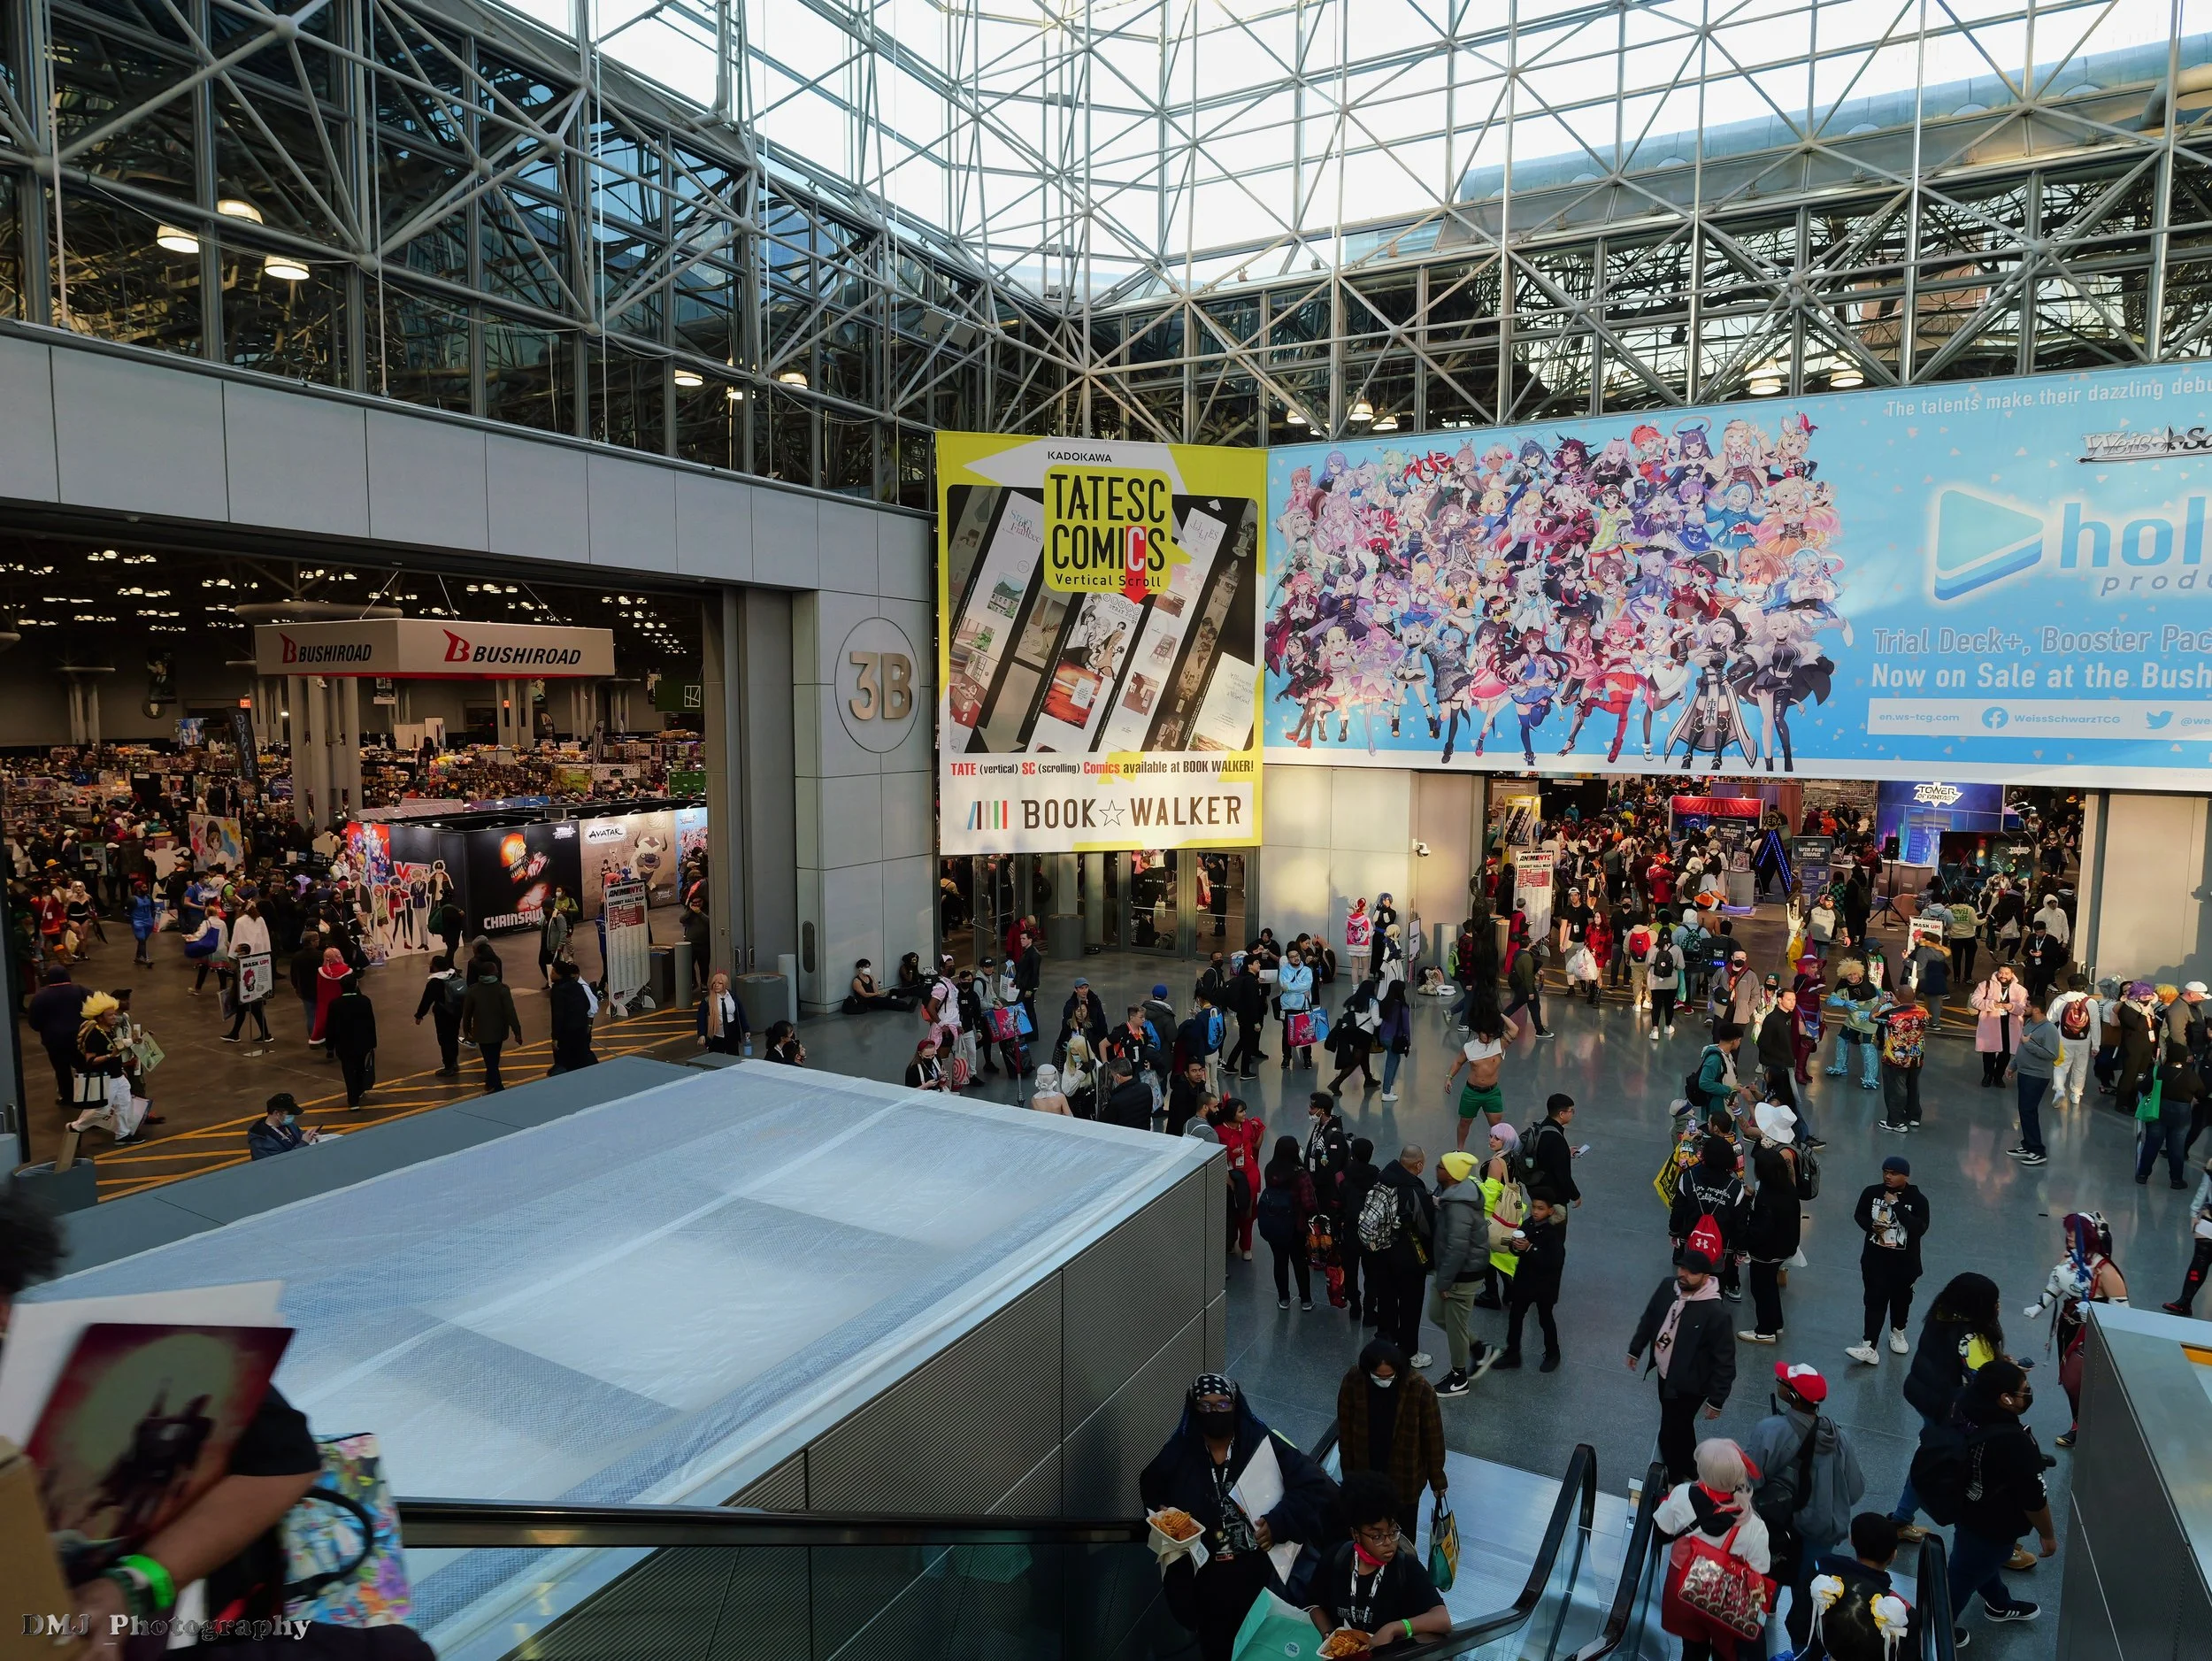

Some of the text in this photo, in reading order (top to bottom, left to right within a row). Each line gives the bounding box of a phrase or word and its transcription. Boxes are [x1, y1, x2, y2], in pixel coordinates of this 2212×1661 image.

[1886, 400, 1915, 417] The
[1922, 396, 1979, 414] talents
[1986, 391, 2032, 409] make
[2039, 387, 2081, 405] their
[2088, 381, 2163, 401] dazzling
[1048, 450, 1112, 463] KADOKAWA
[1049, 473, 1165, 523] TATESC
[2060, 496, 2206, 569] hol
[1052, 524, 1165, 572] COMICS
[1055, 573, 1161, 588] Vertical Scroll
[1873, 627, 1930, 654] Trial
[1939, 627, 2031, 657] Deck+,
[2041, 625, 2152, 653] Booster
[299, 644, 372, 663] BUSHIROAD
[472, 645, 581, 665] BUSHIROAD
[1871, 661, 2212, 688] Now on Sale at the Bush
[849, 651, 913, 721] 3B
[1878, 713, 1960, 723] en.ws-tcg.com
[2015, 714, 2121, 724] WeissSchwarzTCG
[950, 759, 1254, 776] TATE (vertical) SC (scrolling) Comics available at BOOK WALKER!
[1918, 785, 1959, 796] TOWER
[1021, 796, 1241, 829] BOOK WALKER
[588, 827, 623, 839] AVATAR
[608, 898, 624, 907] EXHIBIT
[483, 907, 543, 930] CHAINSAW
[1697, 1192, 1726, 1206] California
